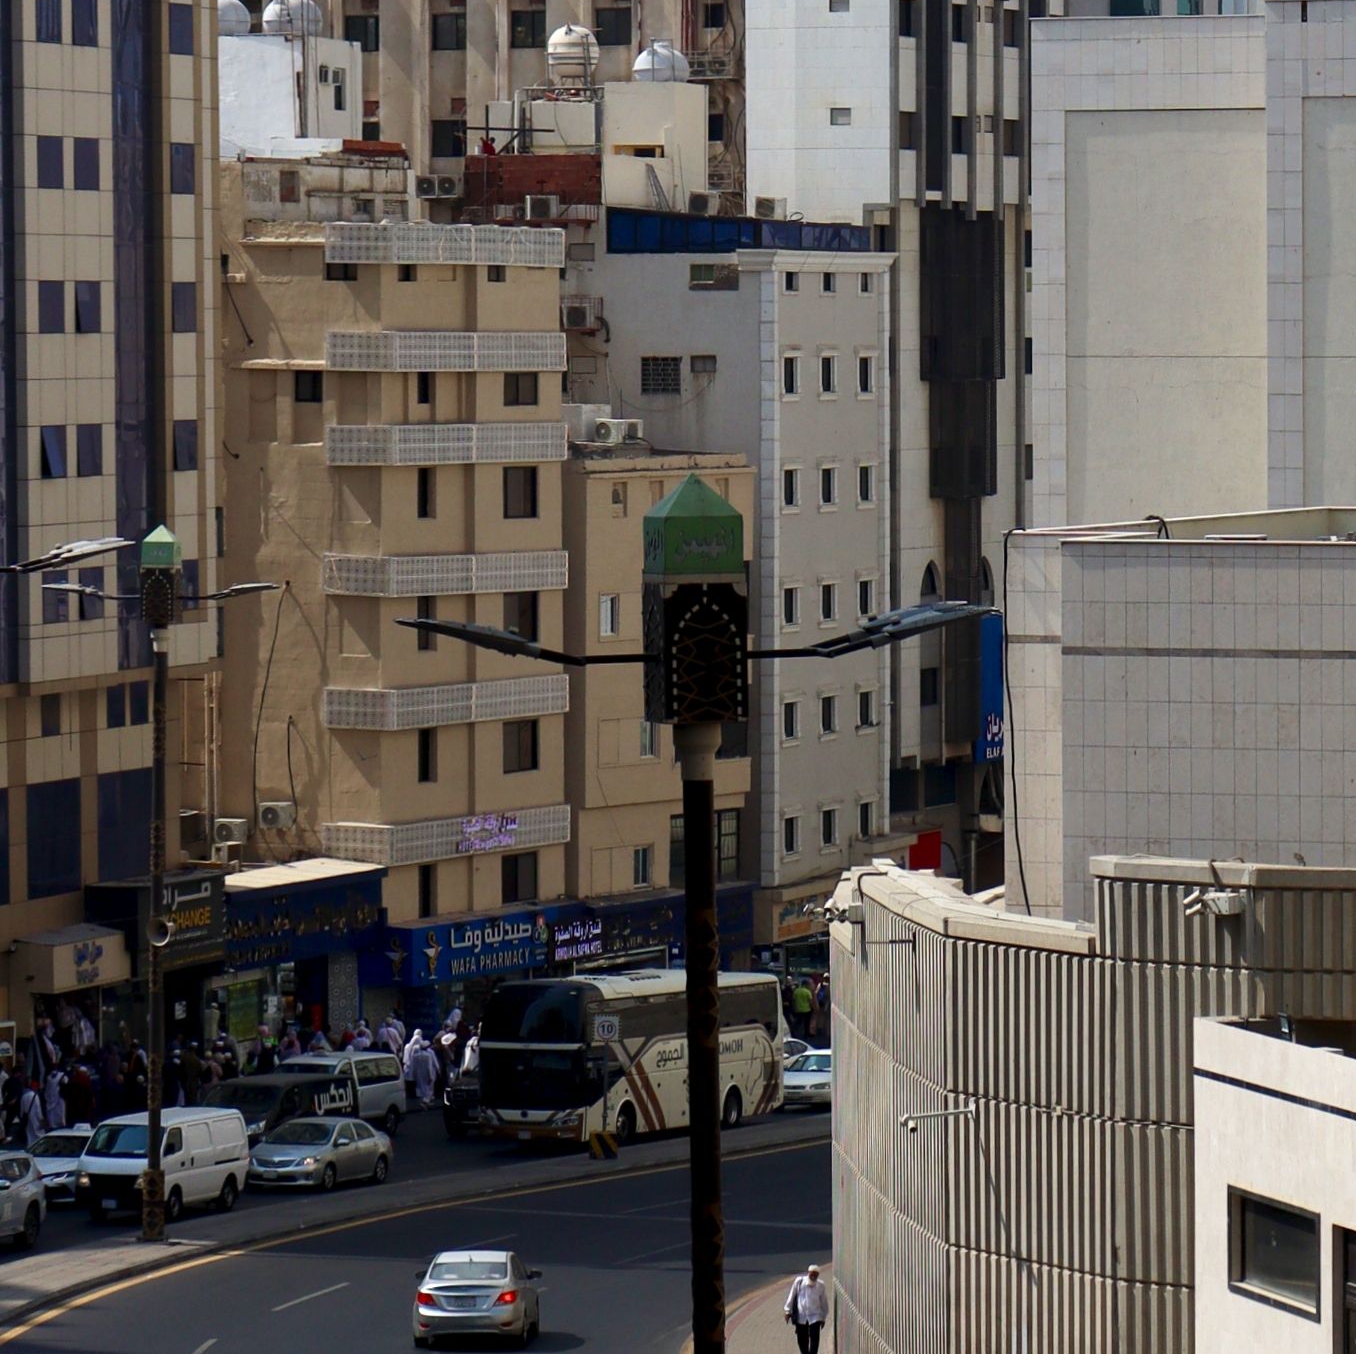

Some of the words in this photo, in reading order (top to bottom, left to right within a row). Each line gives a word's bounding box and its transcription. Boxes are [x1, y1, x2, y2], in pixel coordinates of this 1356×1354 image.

[987, 746, 1000, 759] ELAF
[450, 924, 482, 953] وفا
[451, 957, 477, 976] WAFA
[480, 947, 531, 971] PHARMACY
[601, 1024, 614, 1034] 10
[719, 1038, 743, 1054] OMOH
